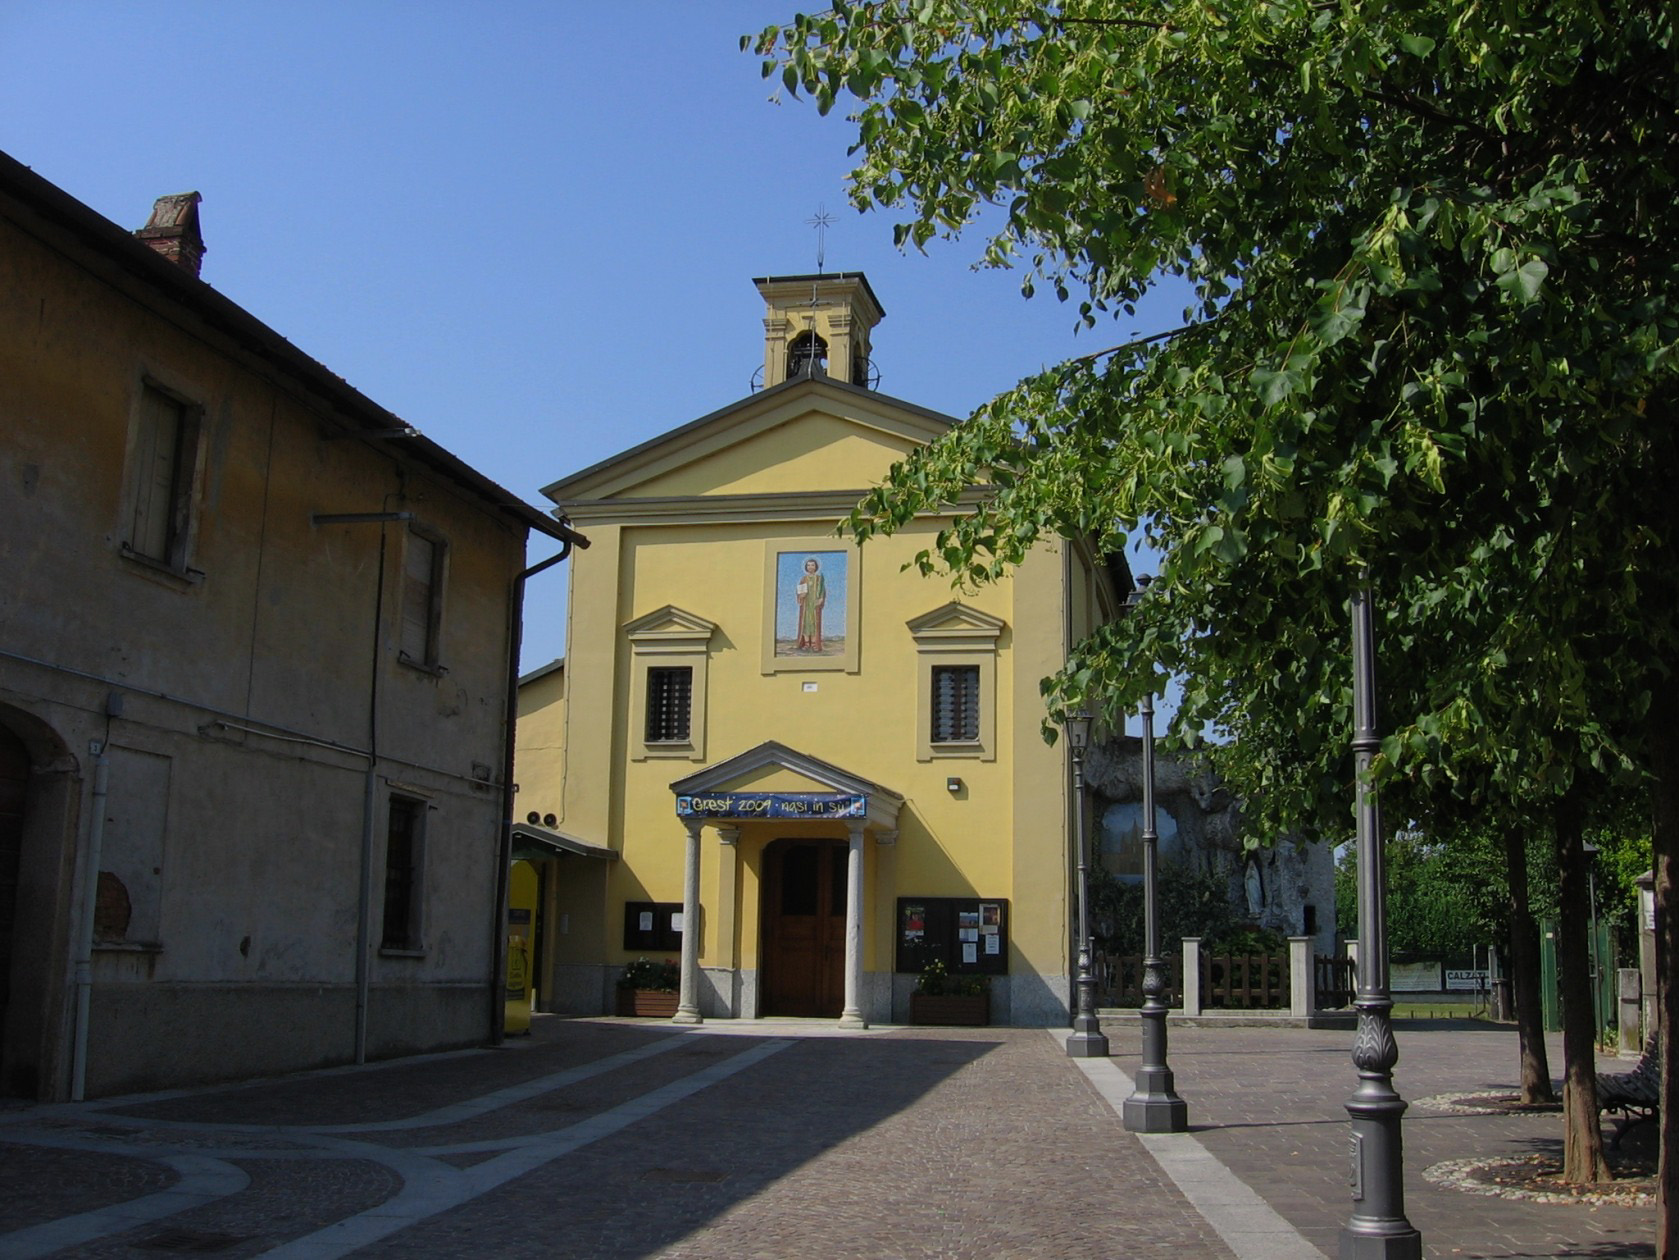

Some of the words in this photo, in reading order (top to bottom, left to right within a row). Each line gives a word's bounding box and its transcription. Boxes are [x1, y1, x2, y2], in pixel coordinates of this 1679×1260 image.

[692, 795, 733, 811] Grest
[738, 798, 772, 811] 2009
[813, 800, 824, 813] in
